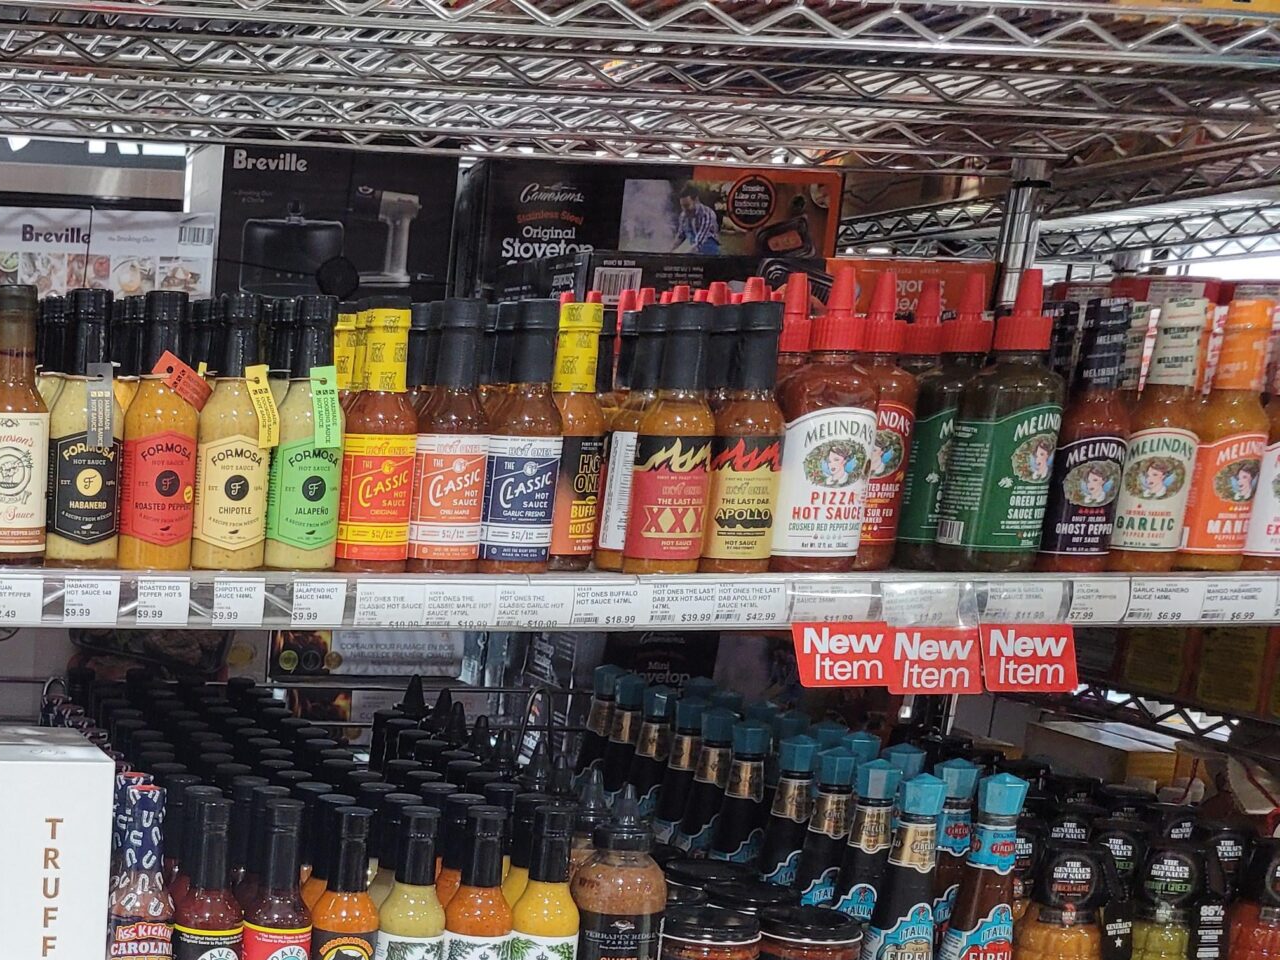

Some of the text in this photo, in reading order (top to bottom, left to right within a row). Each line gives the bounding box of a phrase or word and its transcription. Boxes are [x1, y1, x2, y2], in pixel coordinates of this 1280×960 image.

[233, 149, 307, 173] Breville
[22, 224, 91, 245] Breville
[523, 226, 575, 241] Original
[804, 419, 874, 448] MELINDA'S
[141, 443, 192, 461] FORMOSA
[211, 449, 263, 467] FORMOSA
[289, 449, 339, 467] FORMOSA
[504, 461, 514, 470] THE
[358, 472, 409, 508] CLASSIC
[429, 469, 480, 507] CLASSIC
[499, 470, 551, 509] CLASSIC
[70, 501, 106, 509] HABANERO
[811, 492, 855, 505] PIZZA
[295, 506, 329, 515] JALAPEÑO
[716, 509, 770, 521] APOLLO
[792, 507, 861, 520] HOT SAUCE
[1056, 522, 1081, 534] GHOST
[1116, 517, 1174, 531] GARLIC
[65, 608, 90, 616] $9.99
[138, 609, 162, 618] $9.99
[292, 612, 318, 621] $9.99
[681, 614, 711, 622] $39.99
[746, 612, 776, 621] $42.99
[1158, 612, 1181, 620] $6.99
[1231, 612, 1254, 620] $6.99
[606, 616, 635, 624] $18.99
[804, 627, 884, 654] New
[894, 632, 974, 660] New
[989, 630, 1066, 657] New
[816, 654, 883, 680] Item
[902, 660, 969, 688] Item
[1000, 657, 1064, 684] Item
[41, 818, 64, 957] TRUFF
